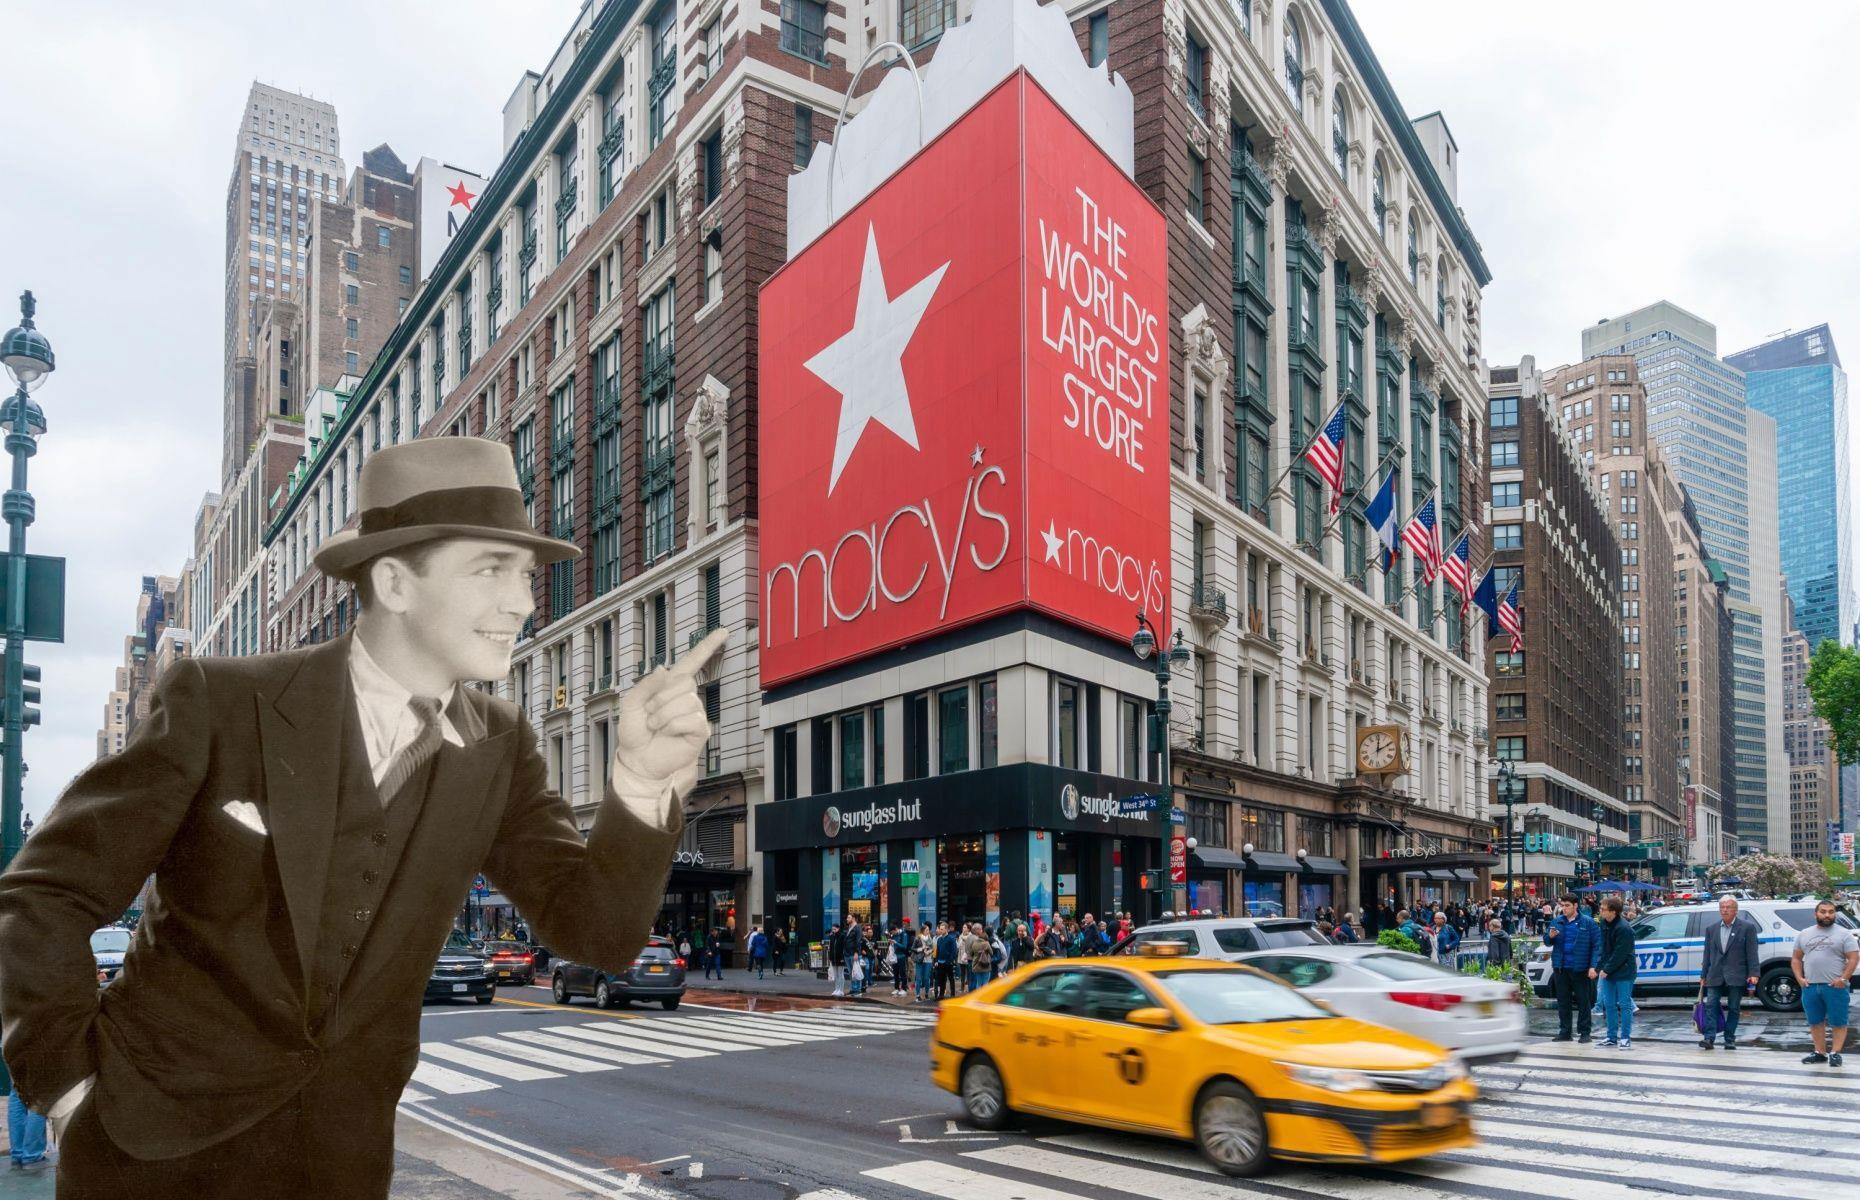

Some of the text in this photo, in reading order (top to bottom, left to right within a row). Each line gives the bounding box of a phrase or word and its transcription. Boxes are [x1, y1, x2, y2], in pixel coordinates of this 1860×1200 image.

[1075, 185, 1128, 281] THE
[1039, 218, 1160, 364] WORLD'S
[1042, 287, 1158, 419] LARGEST
[1063, 372, 1145, 473] STORE
[766, 442, 1010, 649] macy's
[842, 798, 922, 832] sunglass hut
[1081, 792, 1130, 823] sungla
[1122, 801, 1138, 810] West
[1149, 798, 1157, 807] St
[672, 850, 704, 867] acy's
[1634, 952, 1679, 970] YPD
